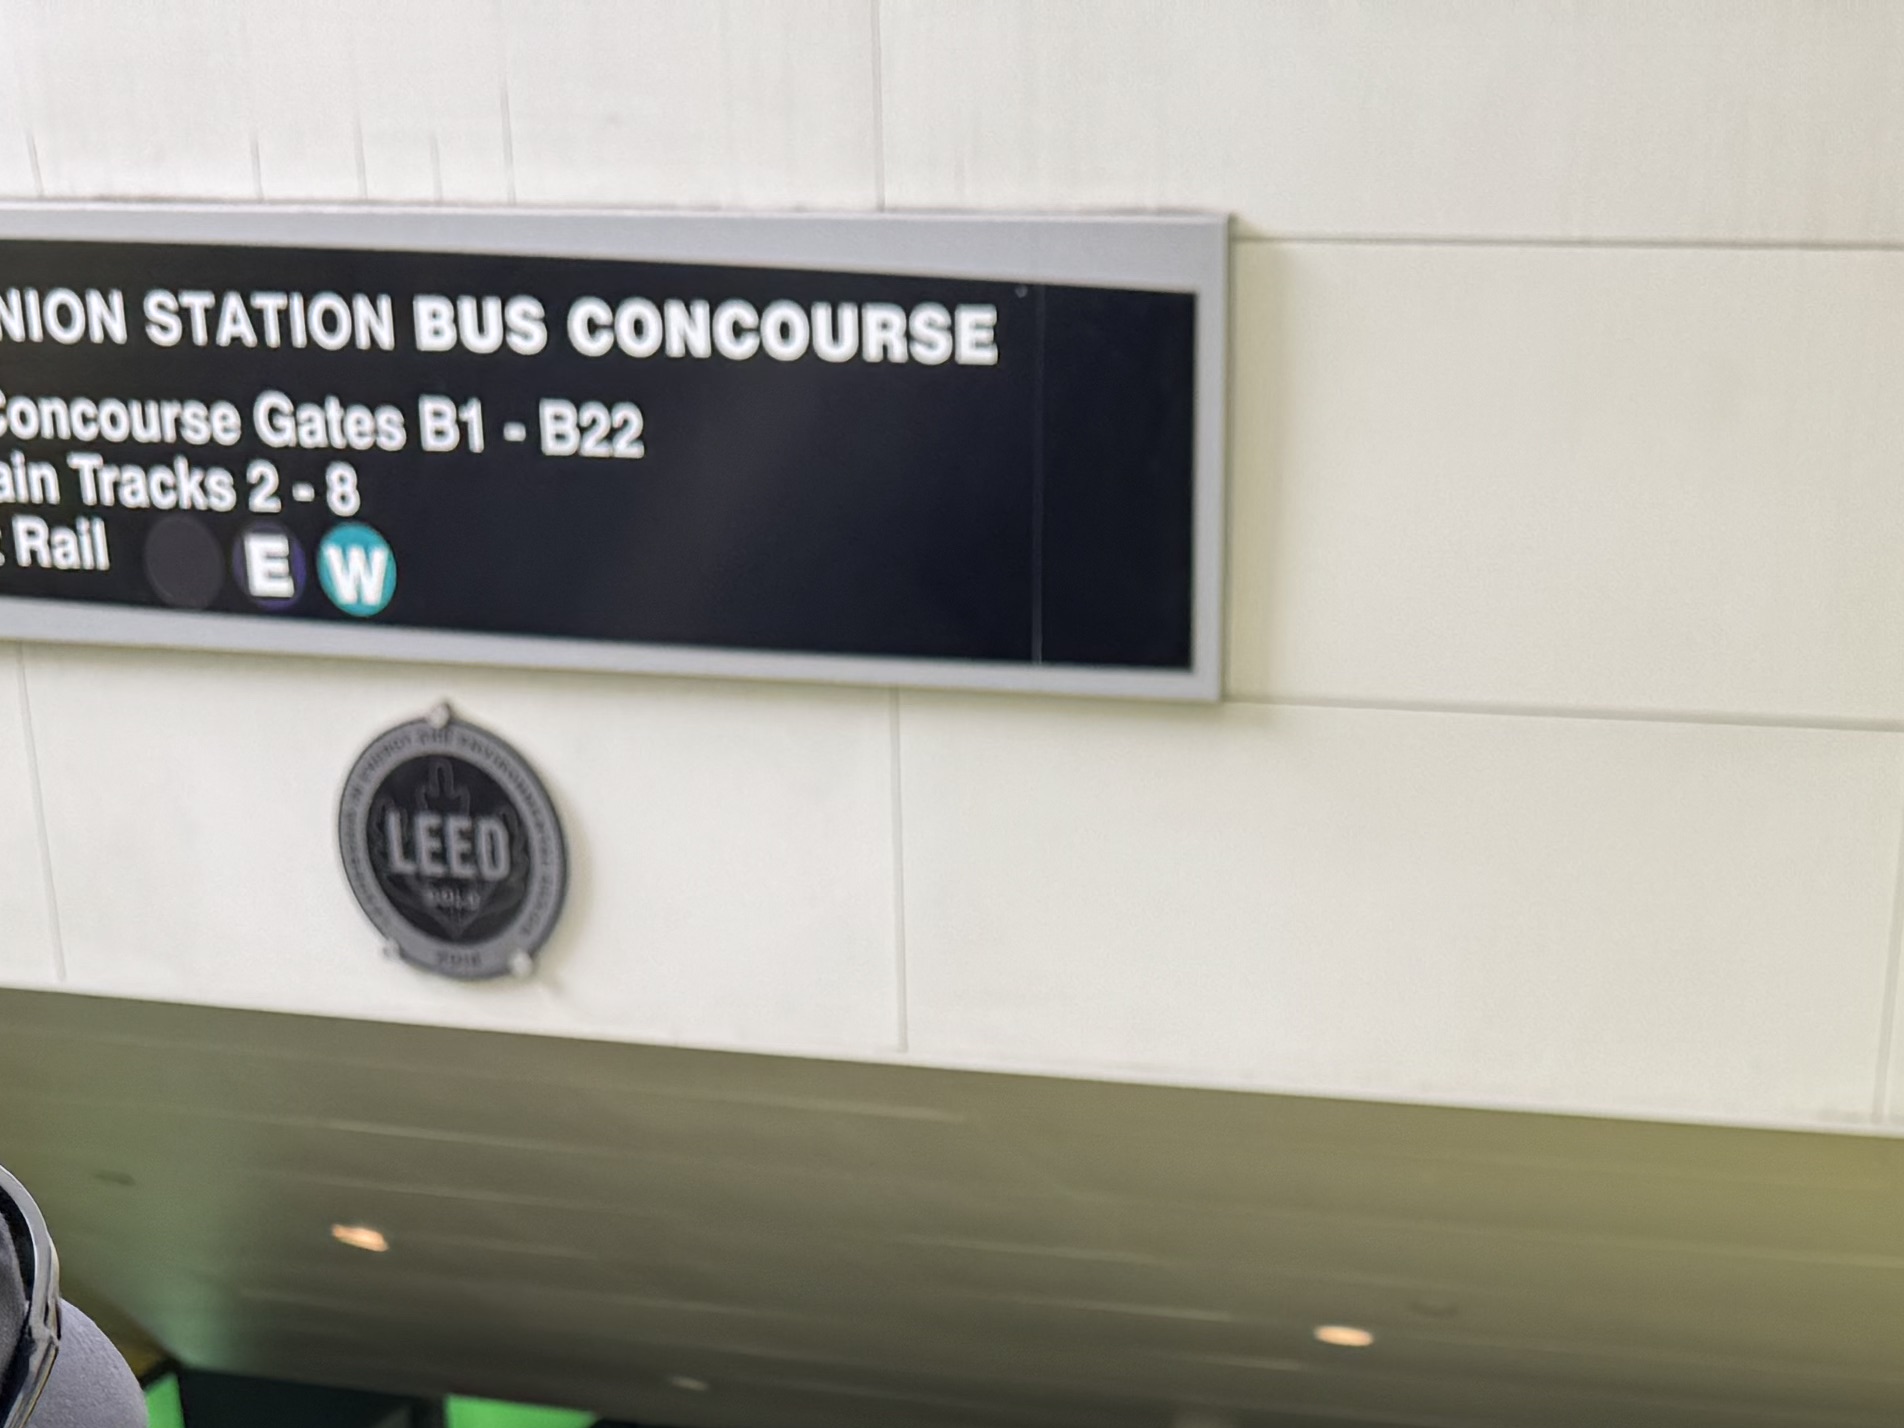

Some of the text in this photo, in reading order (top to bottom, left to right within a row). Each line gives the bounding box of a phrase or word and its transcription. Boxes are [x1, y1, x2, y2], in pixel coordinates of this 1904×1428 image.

[143, 289, 395, 351] STATION
[412, 295, 548, 356] BUS
[567, 297, 998, 365] CONCOURSE
[253, 391, 407, 452] Gates
[418, 396, 485, 453] B1
[539, 399, 645, 459] B22
[65, 451, 237, 512] Tracks
[246, 460, 282, 513] 2
[325, 462, 361, 517] 8
[11, 515, 110, 571] Rail
[244, 534, 296, 598] E
[324, 545, 389, 605] W
[385, 809, 511, 881] LEED
